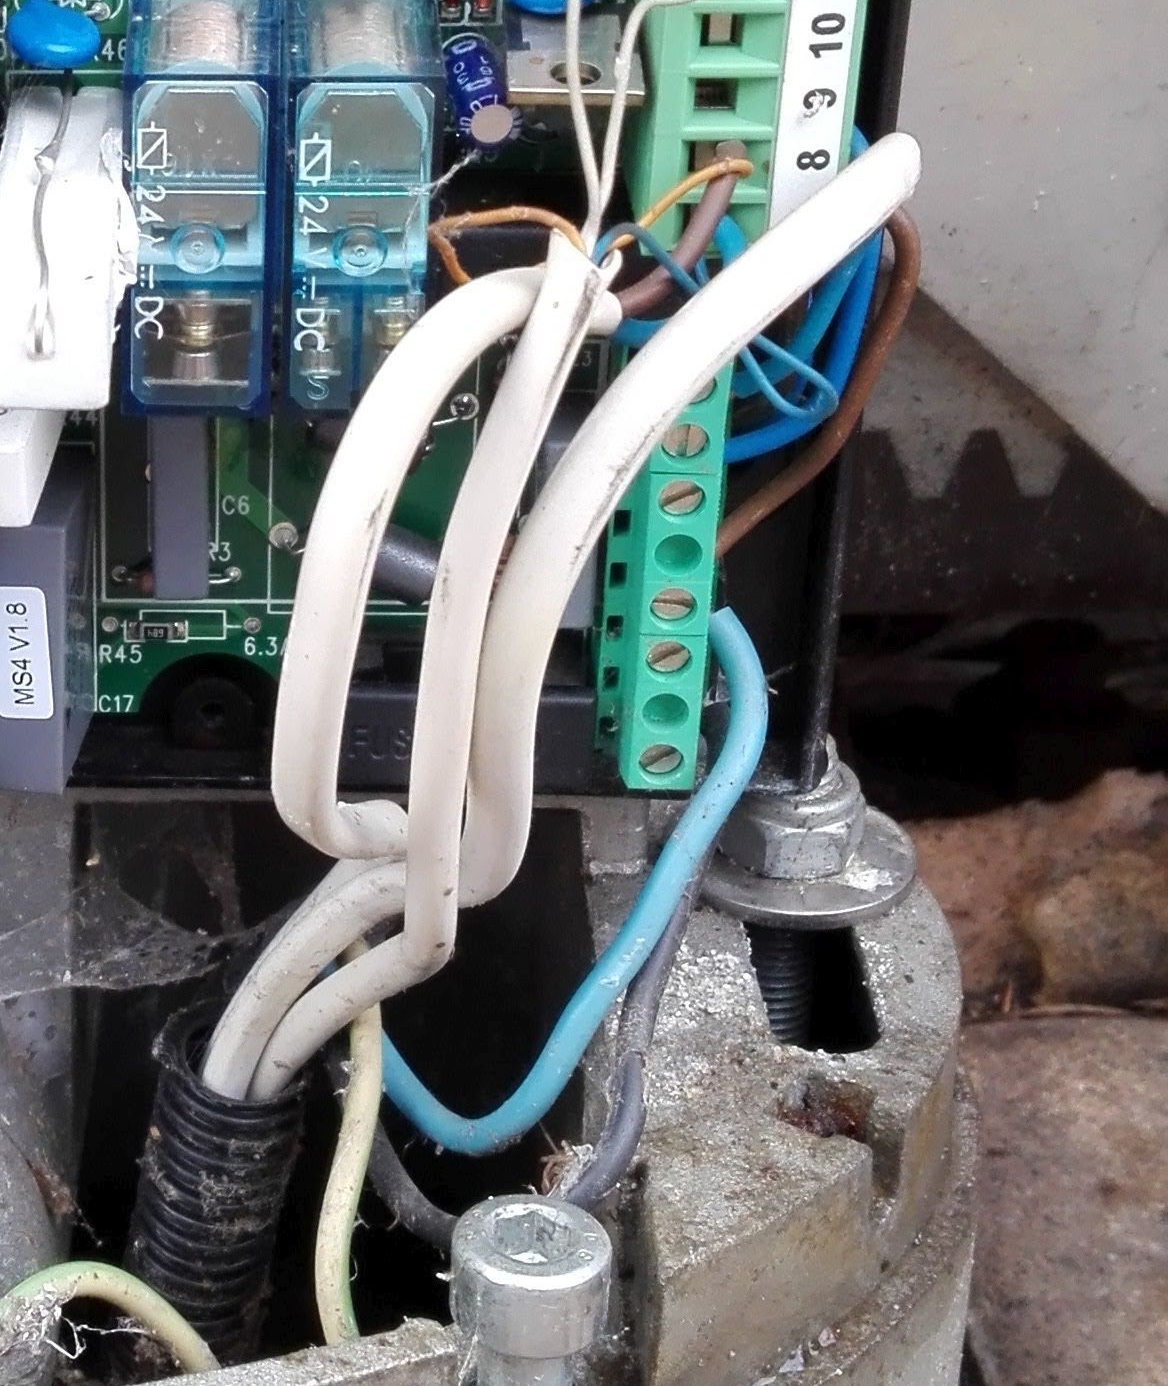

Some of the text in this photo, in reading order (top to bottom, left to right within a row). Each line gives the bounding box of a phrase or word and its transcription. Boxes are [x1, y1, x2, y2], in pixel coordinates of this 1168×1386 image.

[809, 13, 846, 59] 10
[796, 149, 831, 171] 8
[136, 185, 166, 223] 24
[298, 196, 329, 236] 24
[134, 296, 164, 341] DC
[294, 308, 326, 353] DC
[221, 496, 250, 516] C6
[5, 602, 36, 706] MS4 V1.8
[98, 644, 143, 664] R45
[98, 694, 134, 713] C17
[348, 728, 412, 760] FUS
